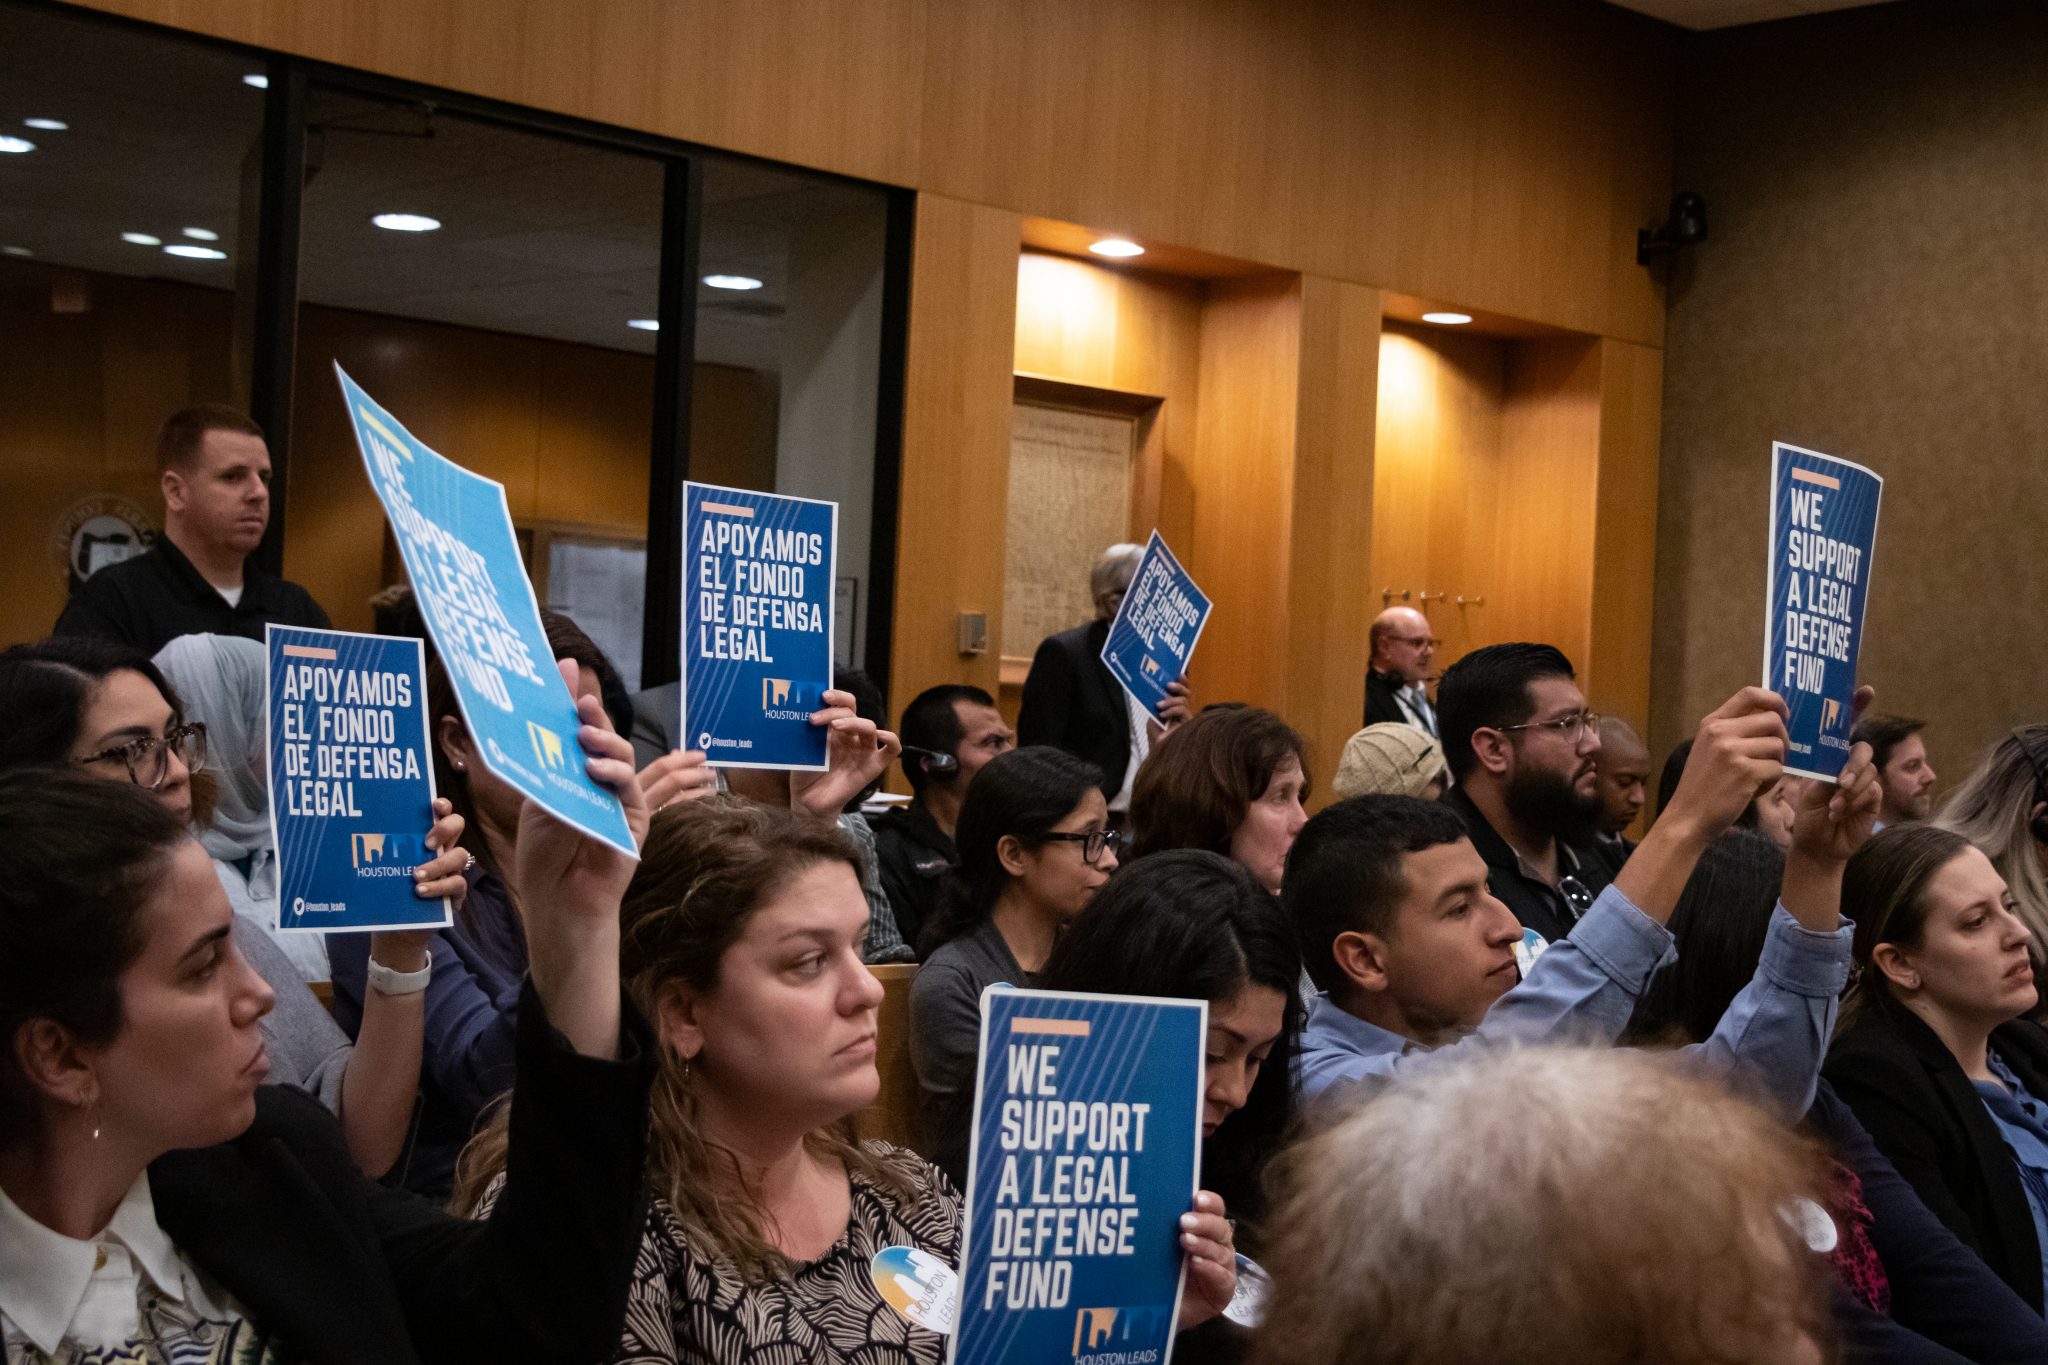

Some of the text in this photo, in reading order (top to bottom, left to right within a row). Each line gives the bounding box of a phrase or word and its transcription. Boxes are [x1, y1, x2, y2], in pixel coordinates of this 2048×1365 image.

[366, 429, 413, 503] WE
[1791, 488, 1822, 531] WE
[384, 482, 498, 596] SUPPORT
[700, 519, 823, 566] APOYAMOS
[1788, 529, 1861, 585] SUPPORT
[423, 551, 521, 638] LEGAL
[700, 555, 804, 598] EL FONDO
[1147, 555, 1199, 627] APOYAMOS
[1787, 571, 1852, 623] A LEGAL
[700, 591, 823, 633] DE DEFENSA
[1127, 602, 1155, 651] LEGAL
[1134, 587, 1186, 661] DE DEFENSA
[1139, 573, 1185, 636] EL FONDO
[422, 582, 545, 686] DEFENSE
[700, 625, 774, 663] LEGAL
[1785, 610, 1851, 662] DEFENSE
[284, 664, 412, 707] APOYAMOS
[443, 631, 514, 713] FUND
[1784, 650, 1825, 695] FUND
[284, 703, 395, 744] EL FONDO
[765, 710, 800, 721] HOUSTON
[285, 743, 421, 780] DE DEFENSA
[712, 737, 753, 749] @houston_leads
[287, 779, 363, 817] LEGAL
[357, 866, 400, 877] HOUSTON
[1008, 1044, 1060, 1095] WE
[1001, 1099, 1150, 1152] SUPPORT
[996, 1154, 1136, 1204] A LEGAL
[991, 1207, 1139, 1257] DEFENSE
[914, 1270, 948, 1319] HOUSTON
[984, 1260, 1073, 1310] FUND
[1075, 1348, 1158, 1365] HOUSTON LEADS
